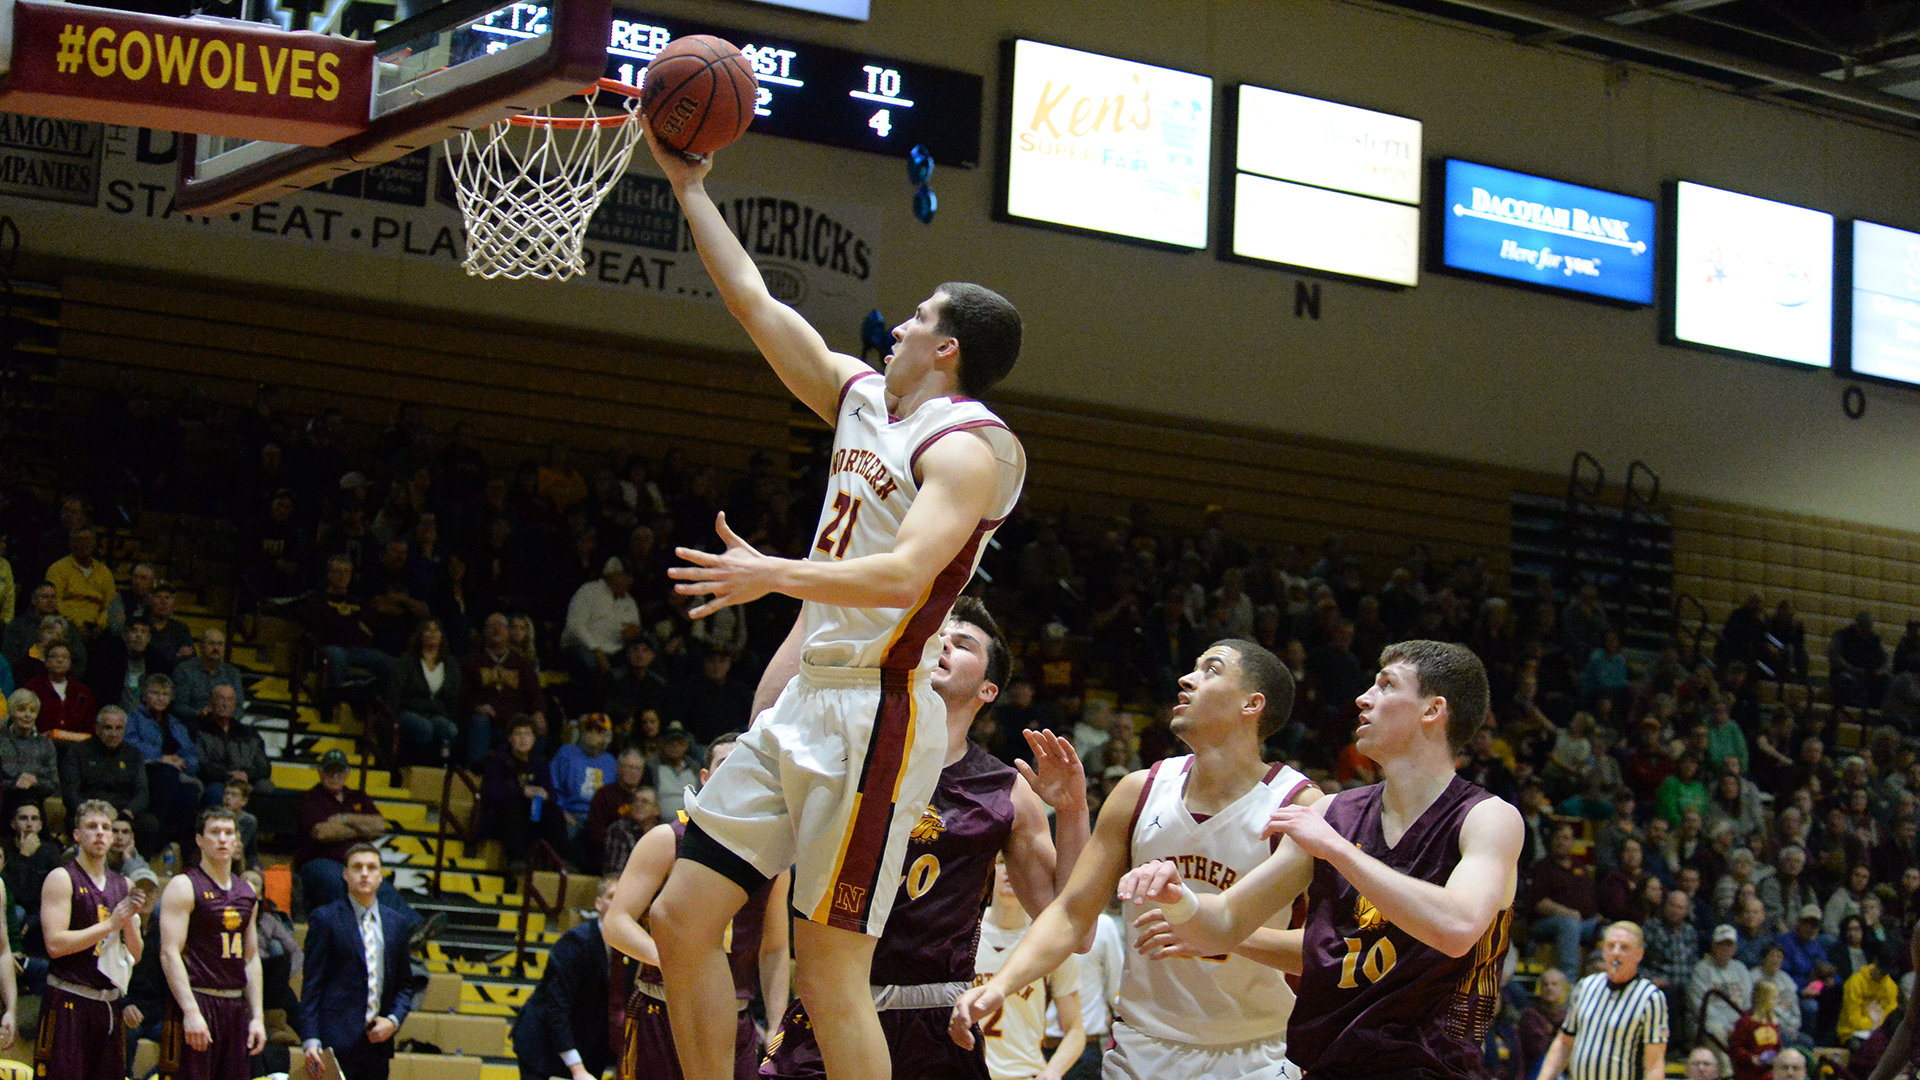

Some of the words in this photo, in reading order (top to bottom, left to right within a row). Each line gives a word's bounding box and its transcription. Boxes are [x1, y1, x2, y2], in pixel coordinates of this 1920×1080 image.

[56, 23, 341, 102] #GOWOLVES
[610, 19, 671, 53] REB
[862, 64, 901, 98] TO
[868, 108, 893, 138] 4
[1029, 72, 1152, 141] Ken's
[250, 201, 343, 241] EAT
[371, 215, 468, 260] PLA
[1471, 187, 1570, 230] DACOTAH
[1572, 207, 1630, 242] BANK
[1500, 239, 1540, 265] Here
[1535, 246, 1564, 271] for
[1295, 281, 1321, 321] N
[815, 488, 864, 561] 21
[834, 881, 866, 913] N
[900, 853, 942, 901] 0
[220, 931, 244, 960] 14
[1337, 935, 1398, 990] 10
